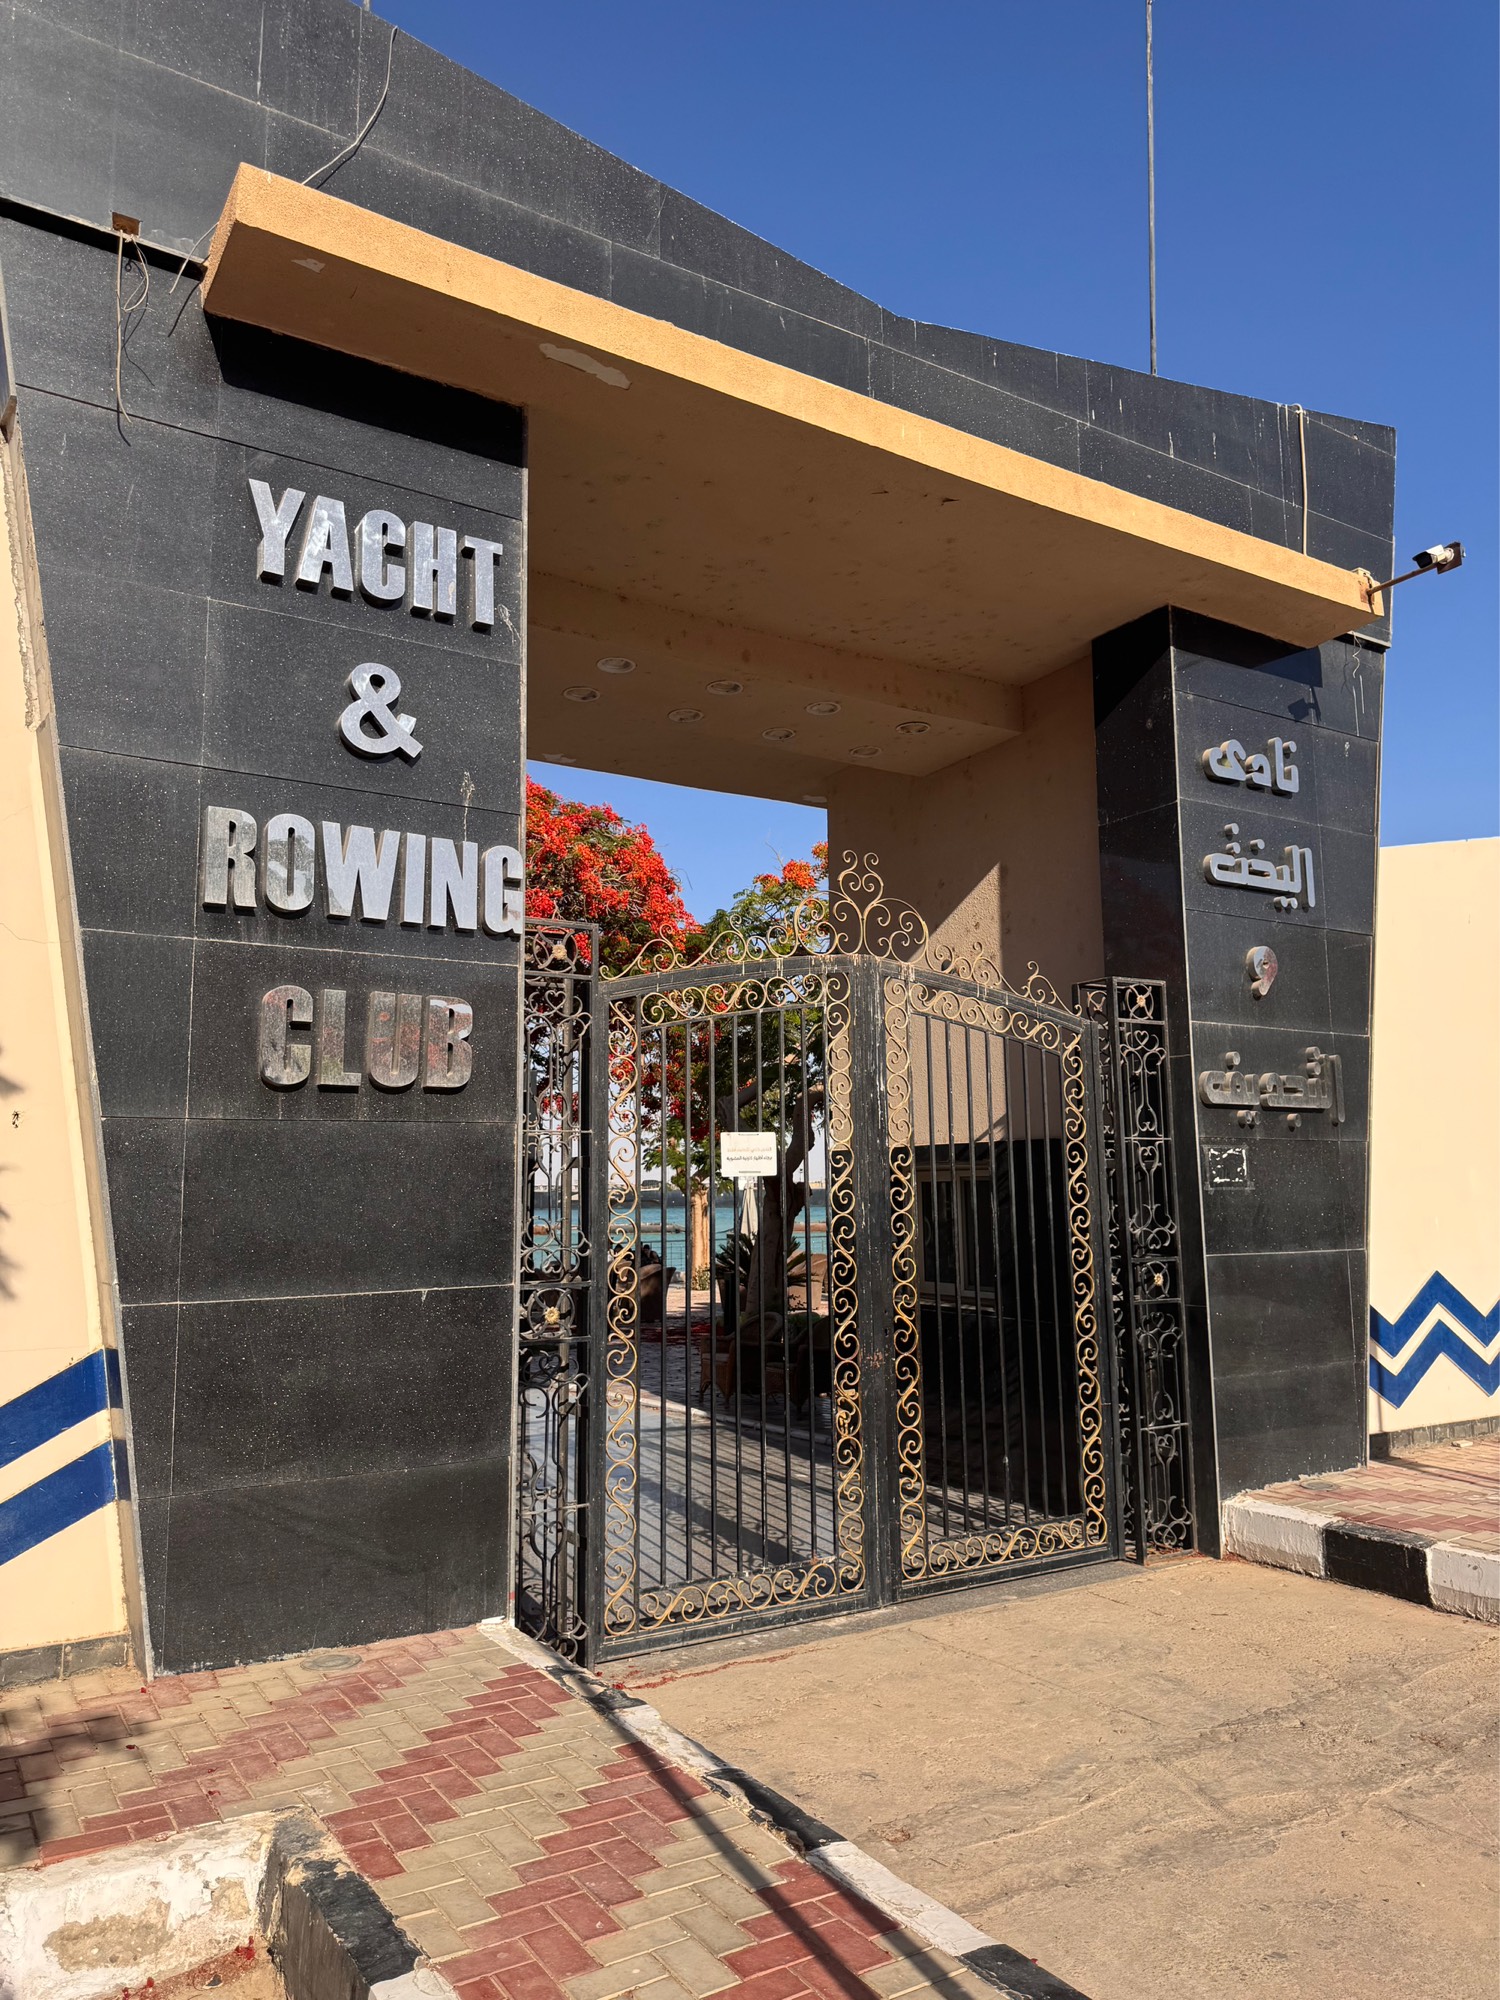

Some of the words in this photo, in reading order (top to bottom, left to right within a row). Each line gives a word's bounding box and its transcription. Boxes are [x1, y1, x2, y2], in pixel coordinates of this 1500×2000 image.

[248, 478, 503, 629] YACHT
[338, 662, 424, 759] &
[201, 805, 525, 936] ROWING
[1203, 822, 1316, 909] اليخت
[1246, 945, 1278, 997] و
[260, 984, 474, 1091] CLUB
[1200, 1046, 1346, 1127] التجديف
